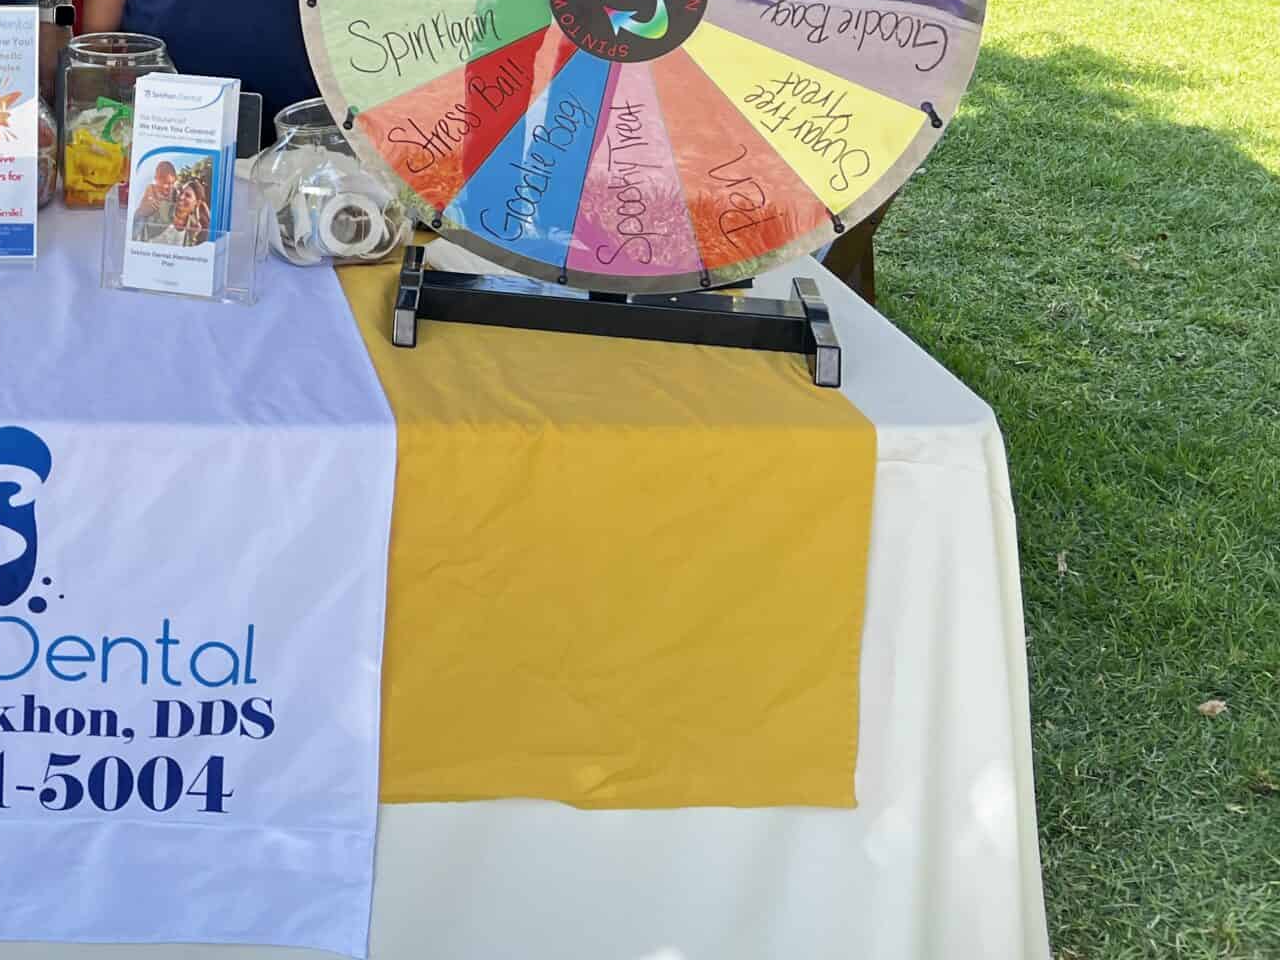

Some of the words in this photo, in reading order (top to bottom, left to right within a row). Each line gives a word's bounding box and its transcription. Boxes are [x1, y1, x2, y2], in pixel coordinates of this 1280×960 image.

[347, 19, 438, 77] Spin
[560, 13, 581, 38] TO
[582, 33, 630, 57] SPIN
[837, 9, 950, 72] Goodie
[170, 125, 184, 134] You
[743, 84, 789, 134] Free
[387, 103, 482, 174] Stress
[8, 171, 22, 181] for
[480, 152, 557, 242] Goodie
[532, 91, 595, 154] Bag
[707, 144, 779, 249] Pen
[151, 696, 275, 741] DDS
